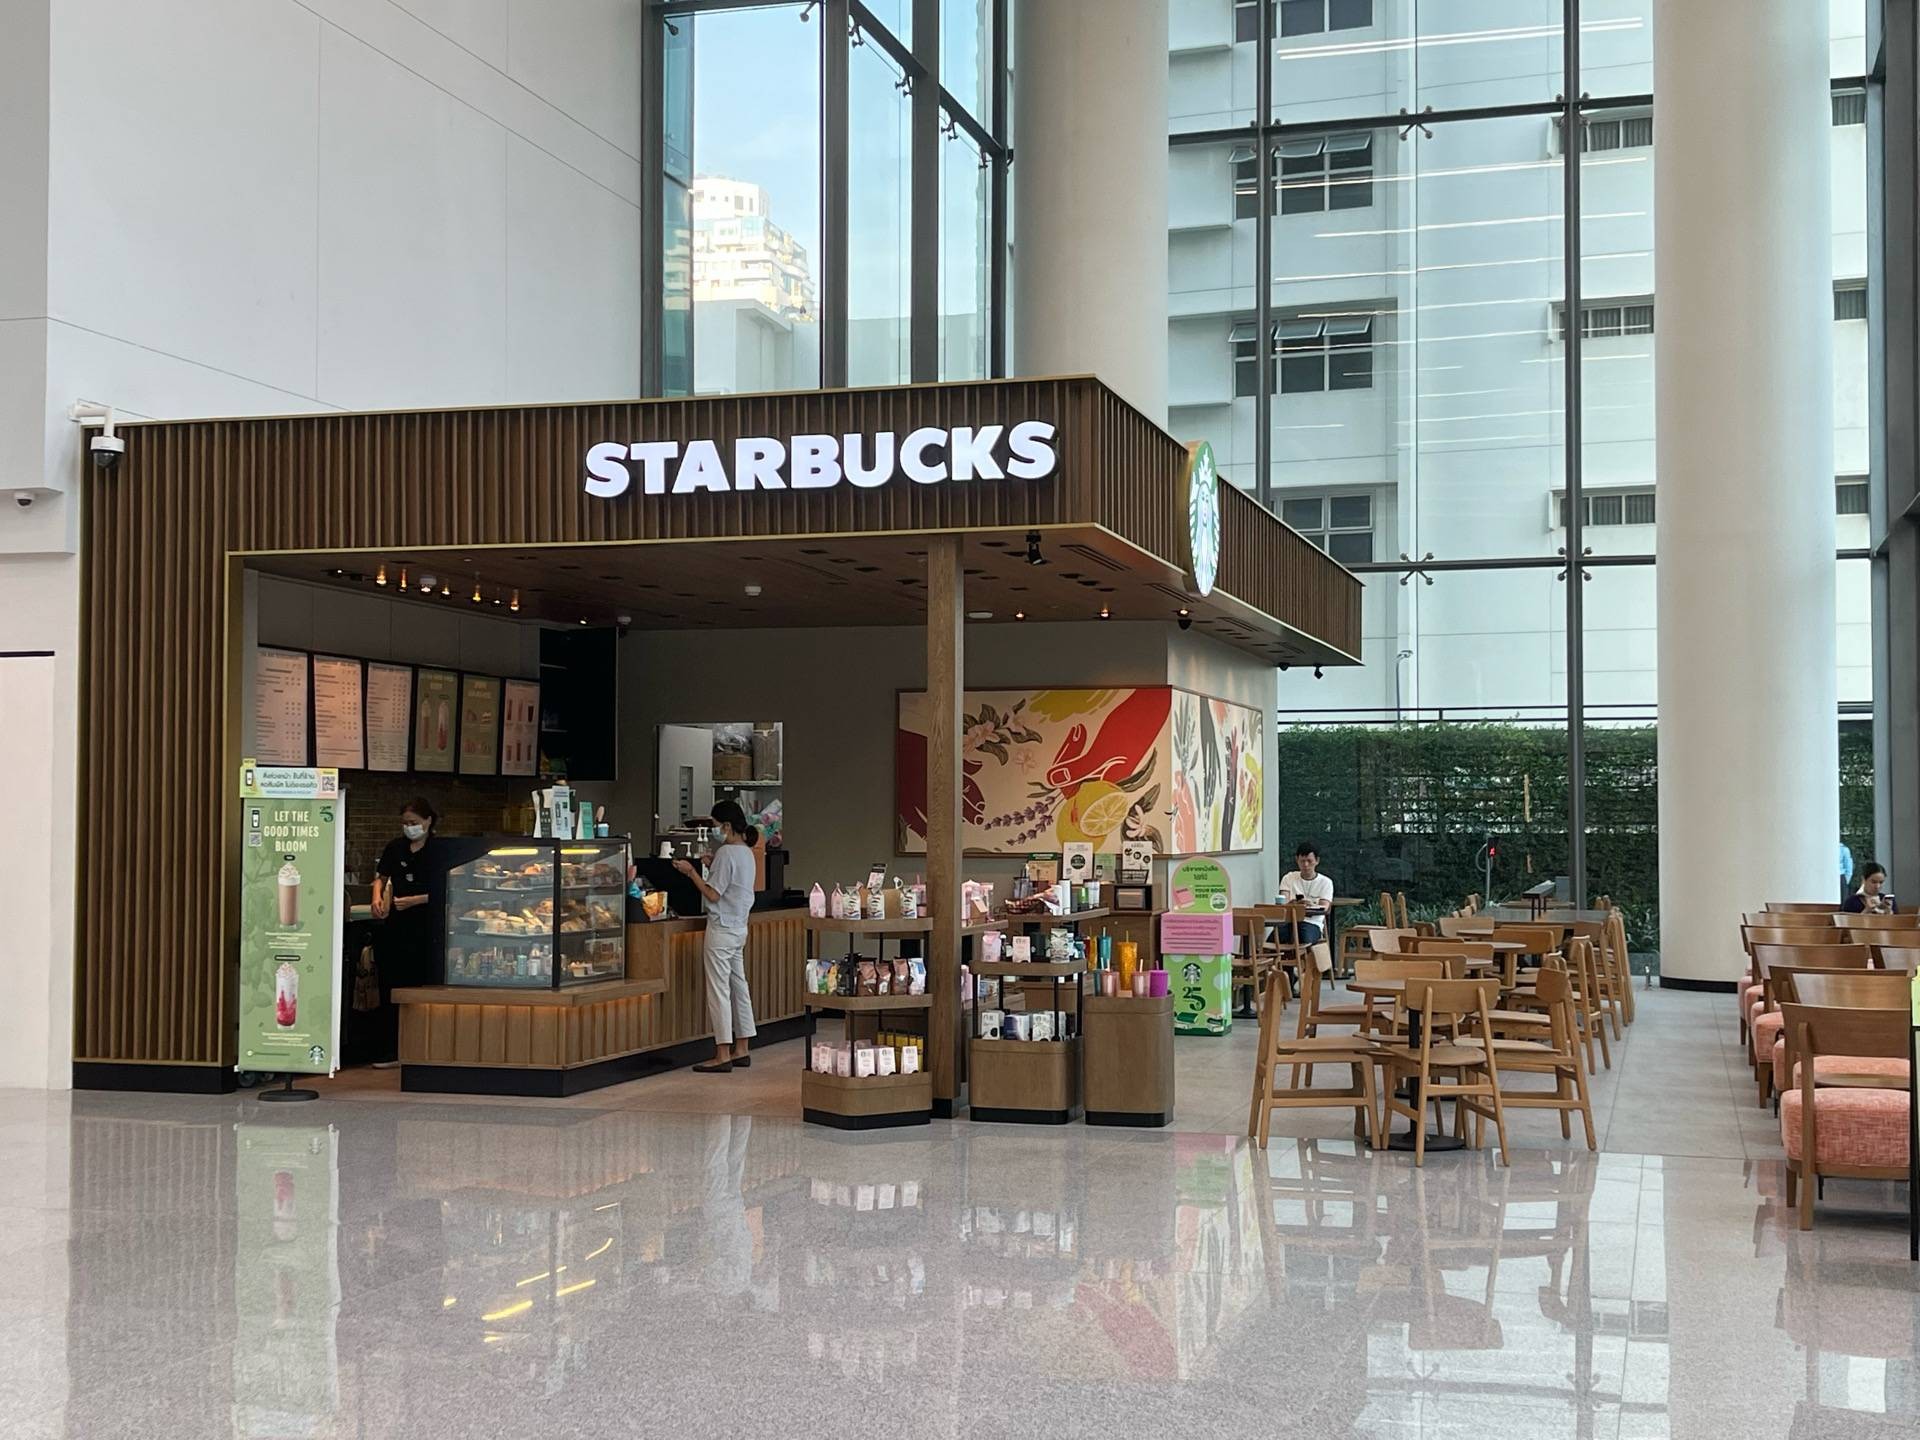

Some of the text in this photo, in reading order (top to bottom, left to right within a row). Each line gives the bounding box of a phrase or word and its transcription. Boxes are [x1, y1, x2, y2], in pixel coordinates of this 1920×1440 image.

[584, 420, 1057, 498] STARBUCKS
[275, 810, 310, 823] LET THE
[263, 826, 319, 838] GOOD TIMES
[275, 840, 308, 852] BLOOM
